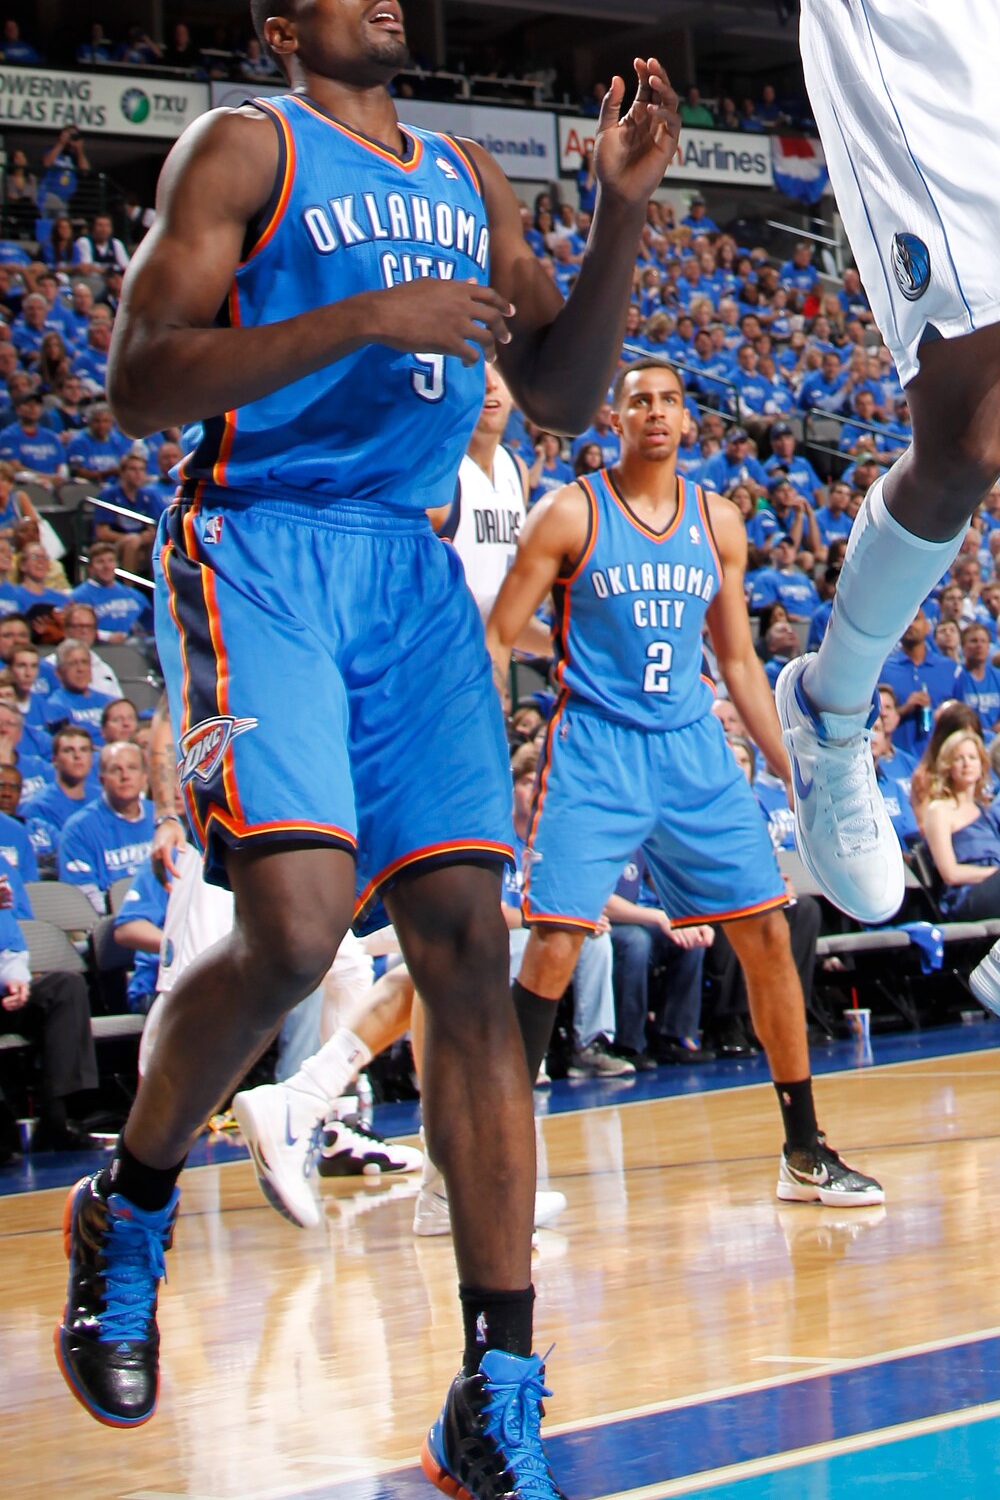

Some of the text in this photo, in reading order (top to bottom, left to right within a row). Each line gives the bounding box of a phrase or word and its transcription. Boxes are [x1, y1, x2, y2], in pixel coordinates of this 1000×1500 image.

[52, 102, 106, 127] FANS
[153, 94, 187, 113] TXU
[302, 192, 490, 270] OKLAHOMA
[592, 563, 714, 601] OKLAHOMA
[633, 599, 685, 628] CITY
[642, 640, 674, 693] 2
[181, 726, 221, 778] OKC
